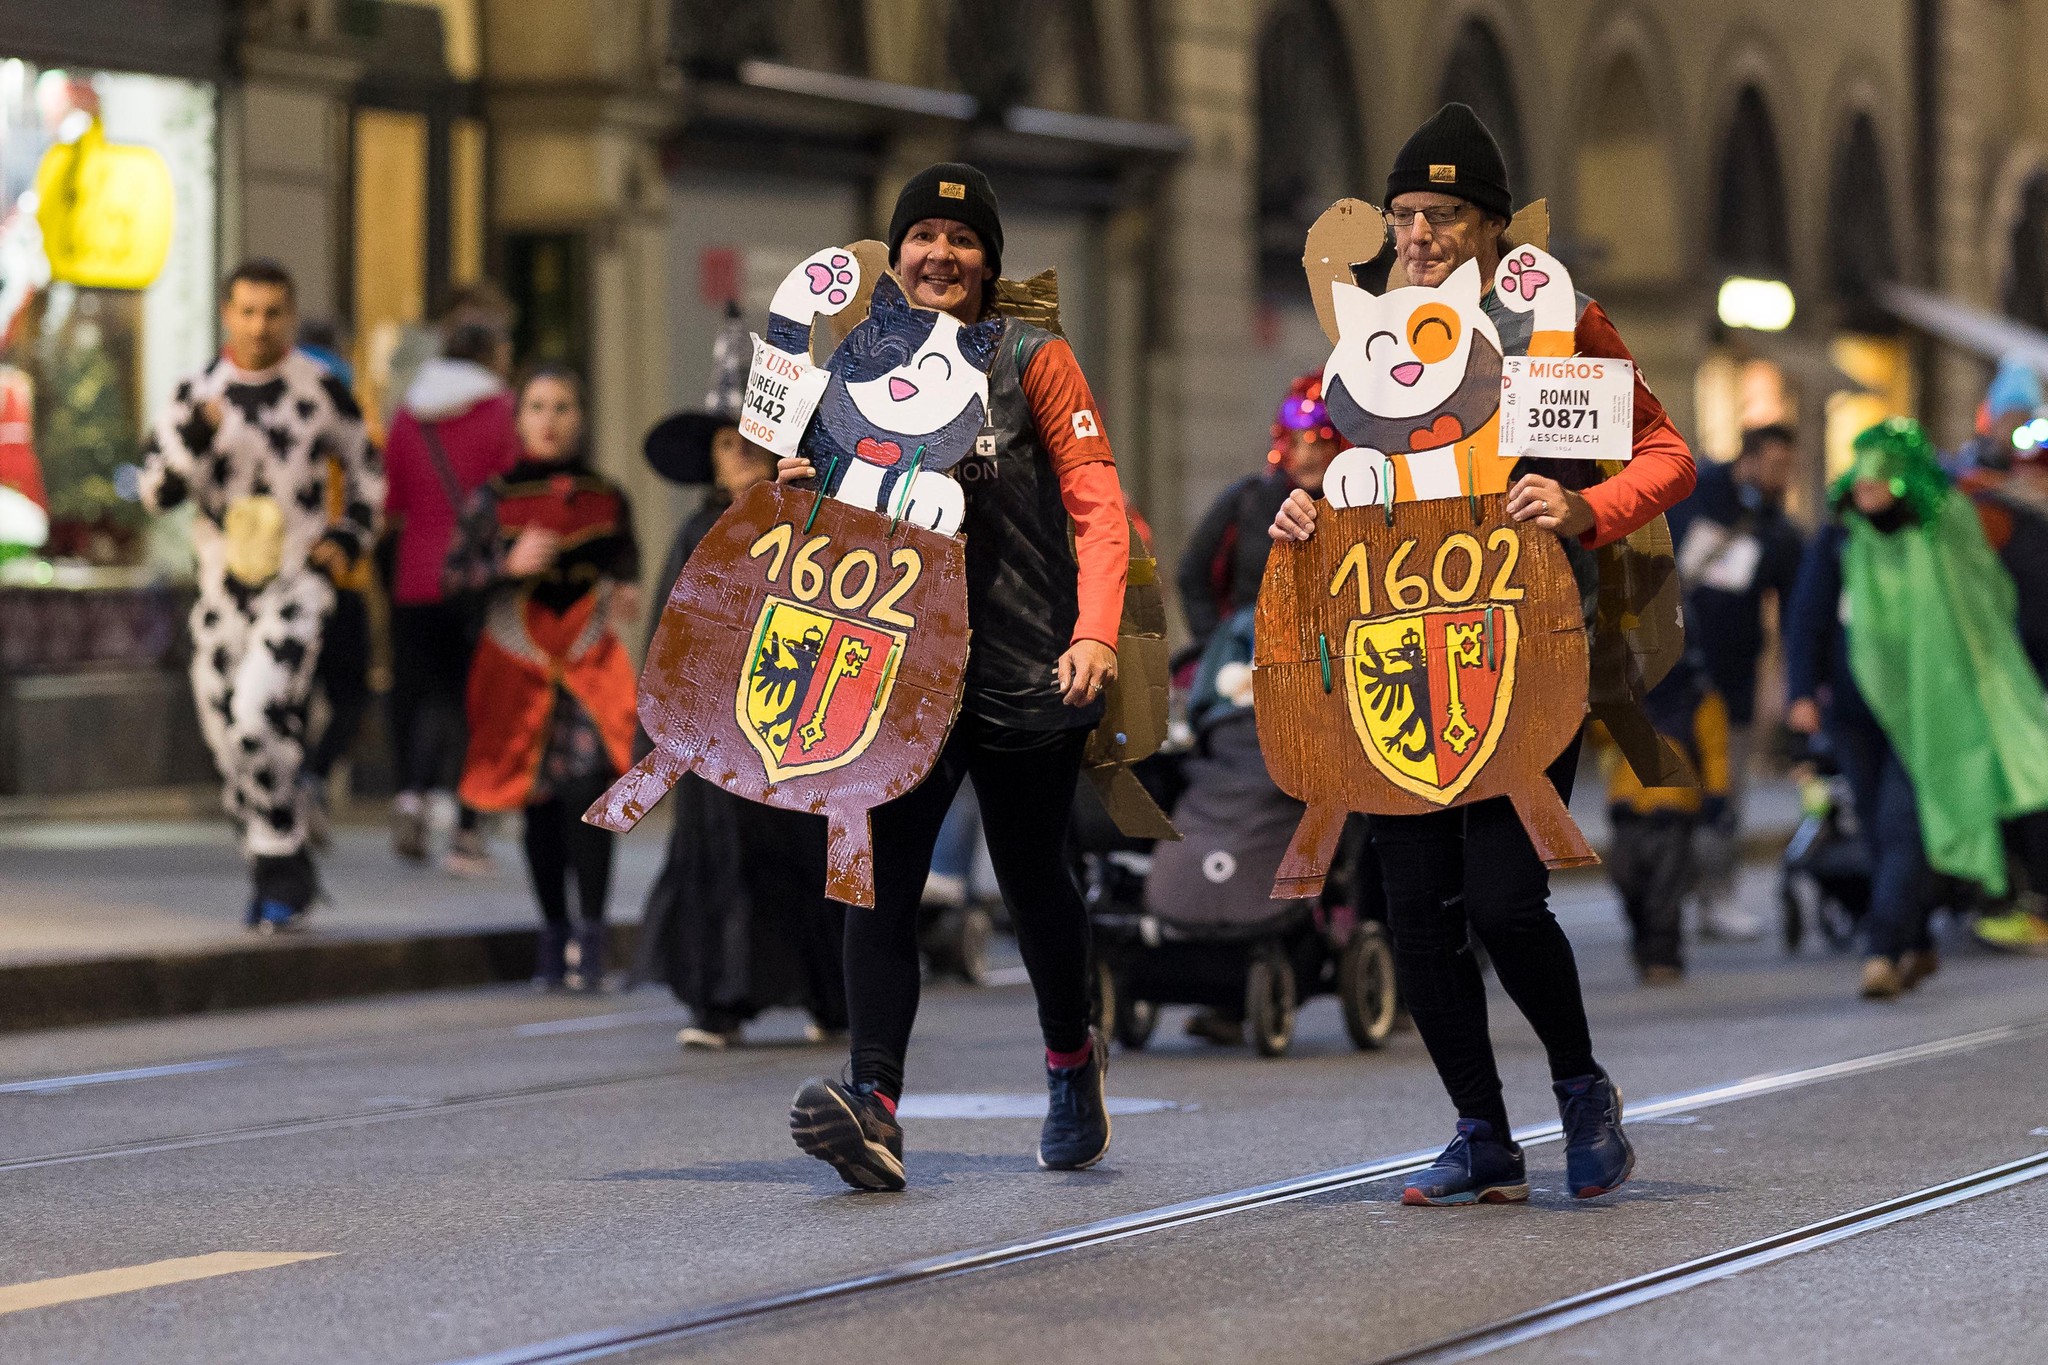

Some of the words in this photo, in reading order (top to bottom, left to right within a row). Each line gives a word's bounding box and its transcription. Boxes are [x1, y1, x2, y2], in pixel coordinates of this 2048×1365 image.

[766, 352, 804, 381] UBS
[1528, 362, 1604, 379] MIGROS
[1539, 389, 1590, 405] ROMIN
[1527, 408, 1598, 429] 30871
[1529, 433, 1600, 443] AESCHBACH
[749, 521, 922, 630] 1602
[1329, 526, 1525, 615] 1602
